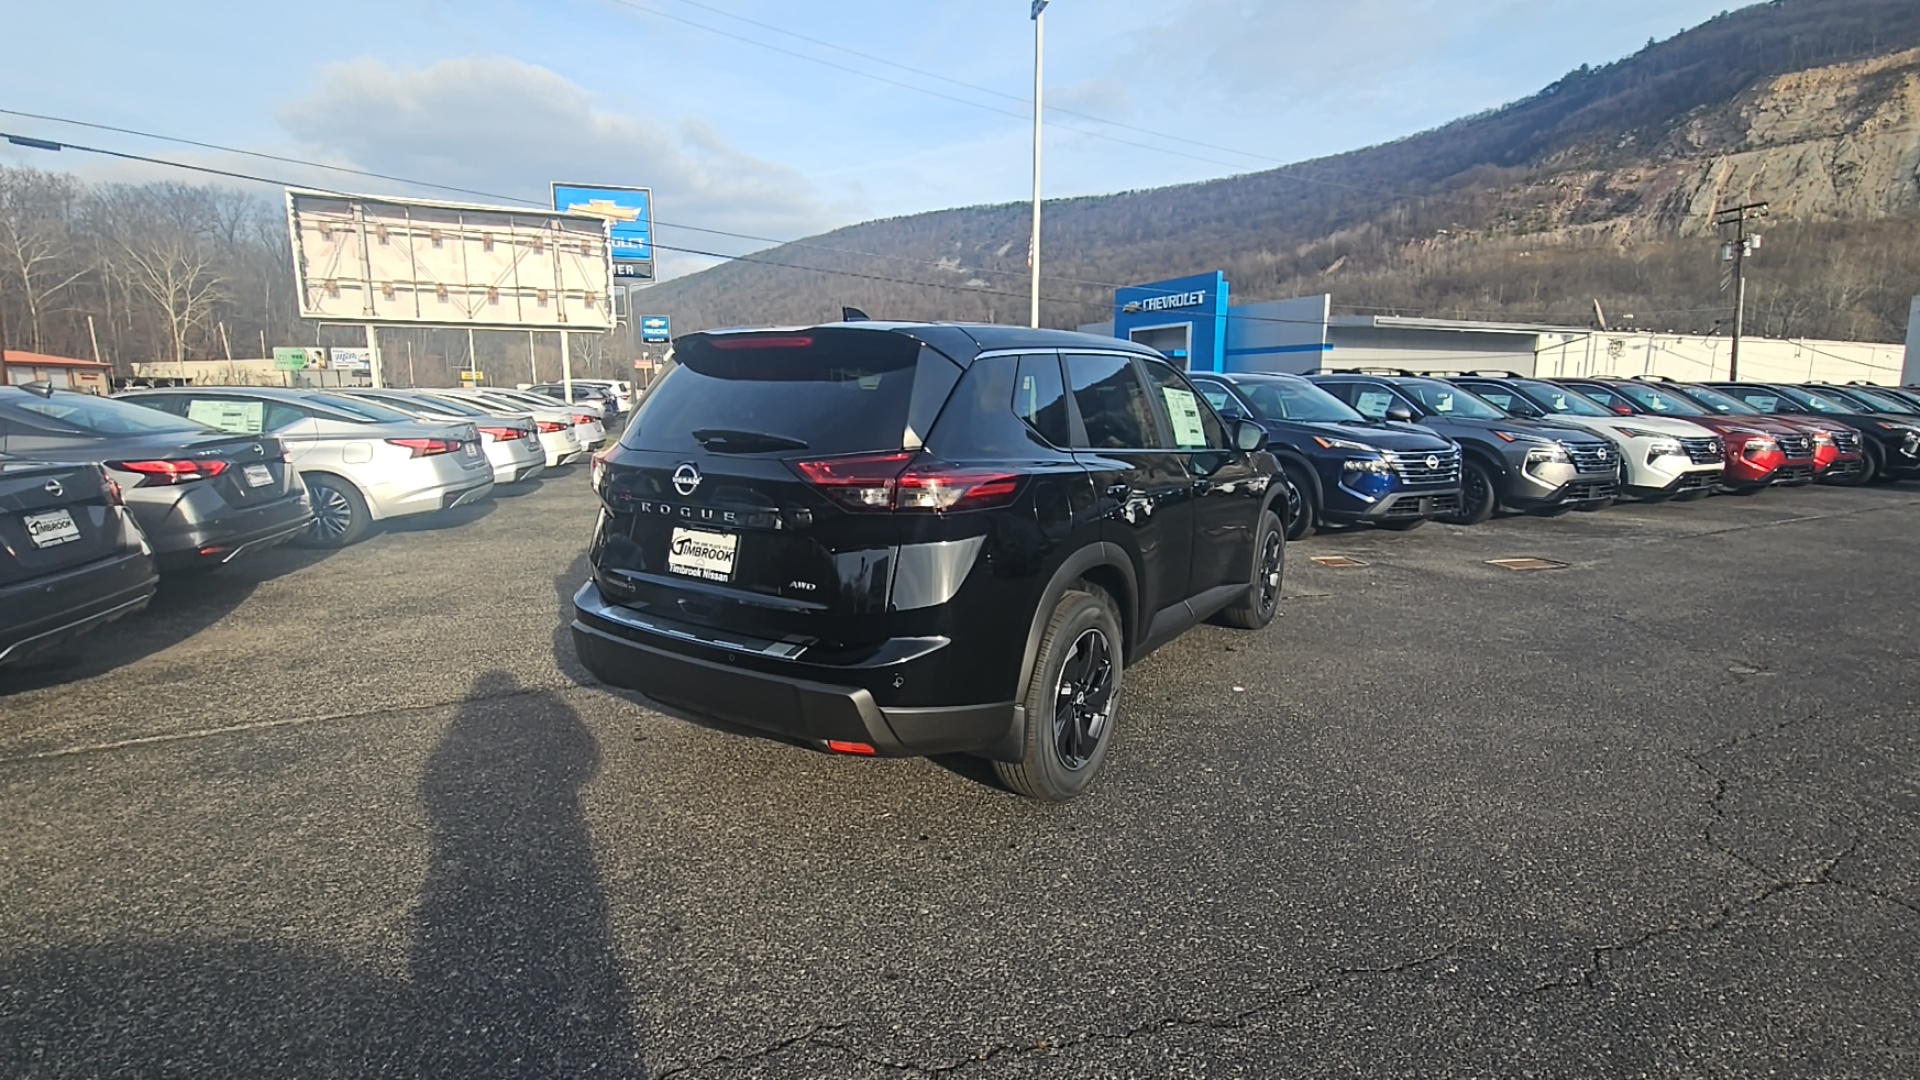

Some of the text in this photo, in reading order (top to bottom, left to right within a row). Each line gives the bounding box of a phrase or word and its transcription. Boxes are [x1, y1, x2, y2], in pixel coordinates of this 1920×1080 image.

[1142, 289, 1206, 312] CHEVROLET
[641, 501, 736, 522] ROGUE
[672, 536, 735, 563] TIMBROOK
[669, 563, 729, 583] Timbrook Nissan
[789, 580, 817, 591] AWD
